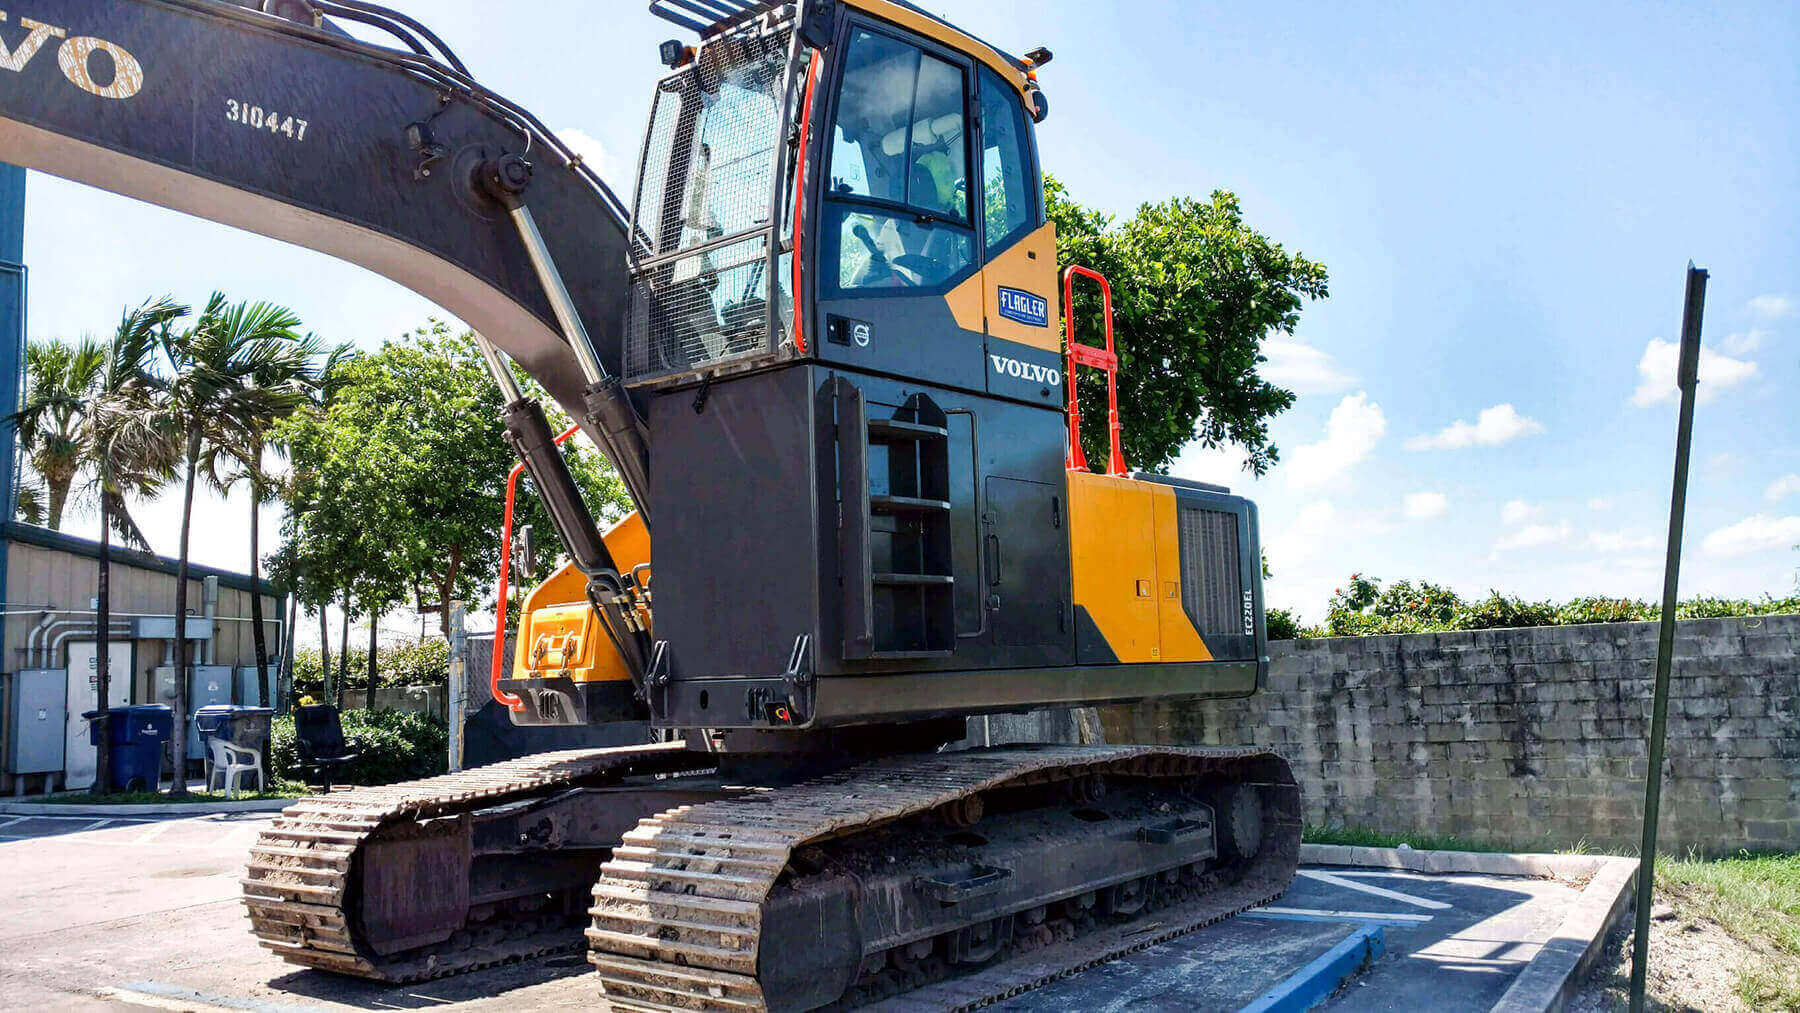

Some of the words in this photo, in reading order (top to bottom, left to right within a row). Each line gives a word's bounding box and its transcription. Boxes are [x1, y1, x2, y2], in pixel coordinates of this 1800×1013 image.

[226, 99, 307, 141] 310447
[1001, 291, 1045, 318] FLAGLER
[990, 354, 1060, 386] VOLVO
[1243, 589, 1254, 636] EC220EL
